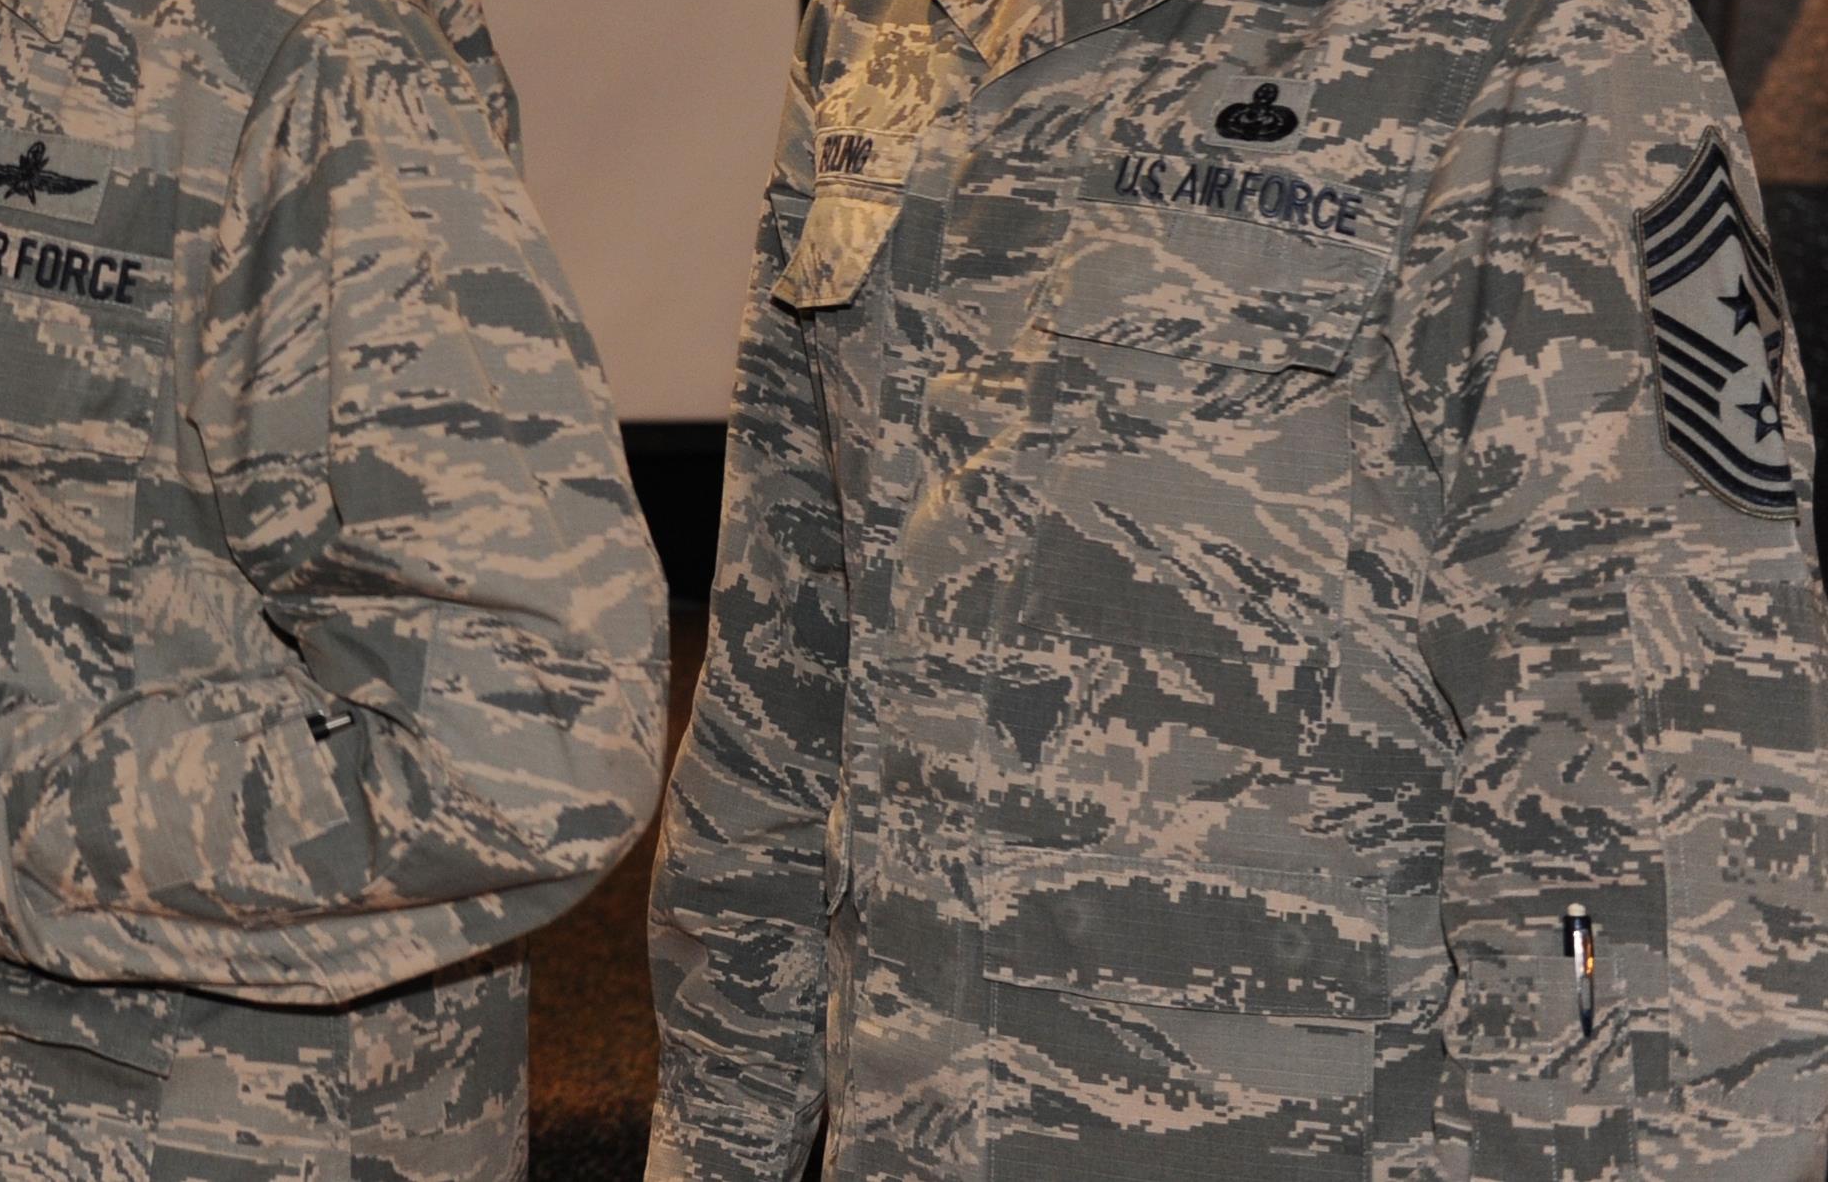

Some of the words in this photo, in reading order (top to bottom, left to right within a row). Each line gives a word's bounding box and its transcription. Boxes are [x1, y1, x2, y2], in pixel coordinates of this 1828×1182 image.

[1171, 164, 1236, 209] AIR
[1235, 171, 1363, 237] FORCE
[14, 237, 142, 304] FORCE
